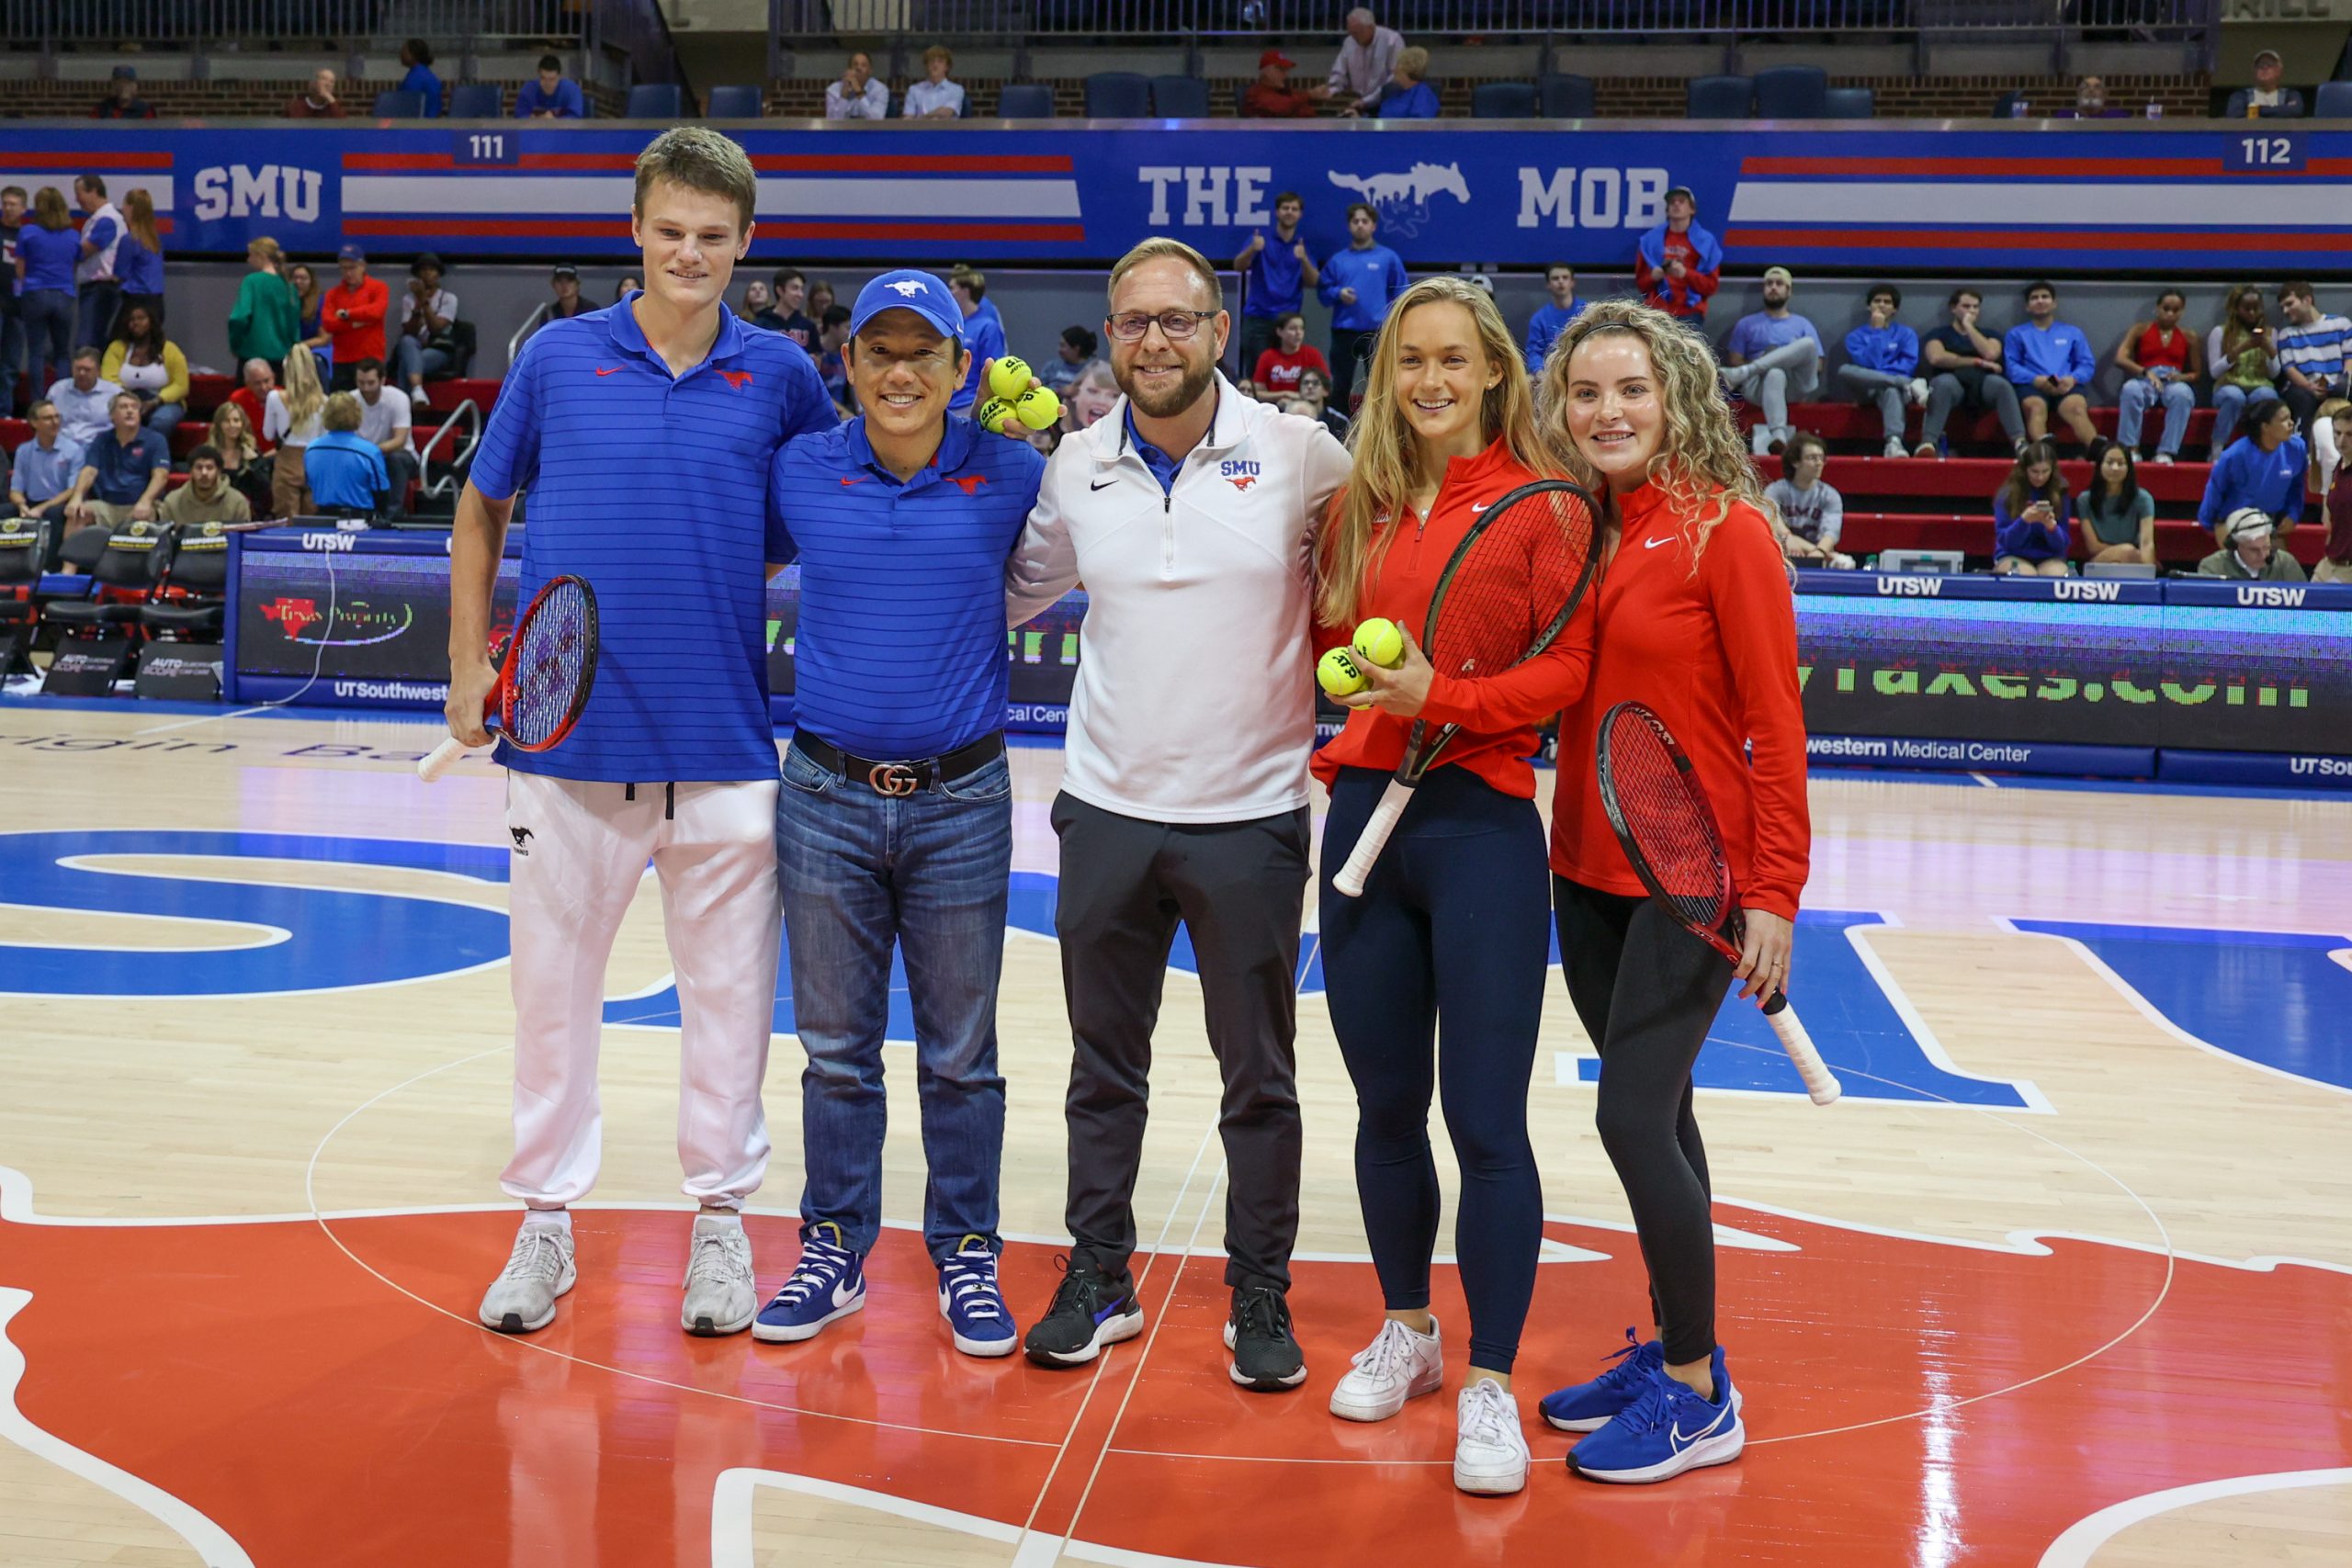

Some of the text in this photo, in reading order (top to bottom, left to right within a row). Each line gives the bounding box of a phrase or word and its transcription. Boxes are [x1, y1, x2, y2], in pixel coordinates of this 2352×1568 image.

[469, 134, 503, 159] 111
[2242, 138, 2291, 164] 112
[194, 164, 322, 223] SMU
[1138, 166, 1669, 230] THE MOB
[1221, 460, 1261, 476] SMU
[302, 533, 356, 551] UTSW
[1877, 576, 1943, 595] UTSW
[2053, 581, 2120, 601] UTSW
[2237, 586, 2306, 607] UTSW
[151, 657, 184, 669] AUTO
[1893, 740, 1964, 760] Medical
[1969, 743, 2031, 763] Center
